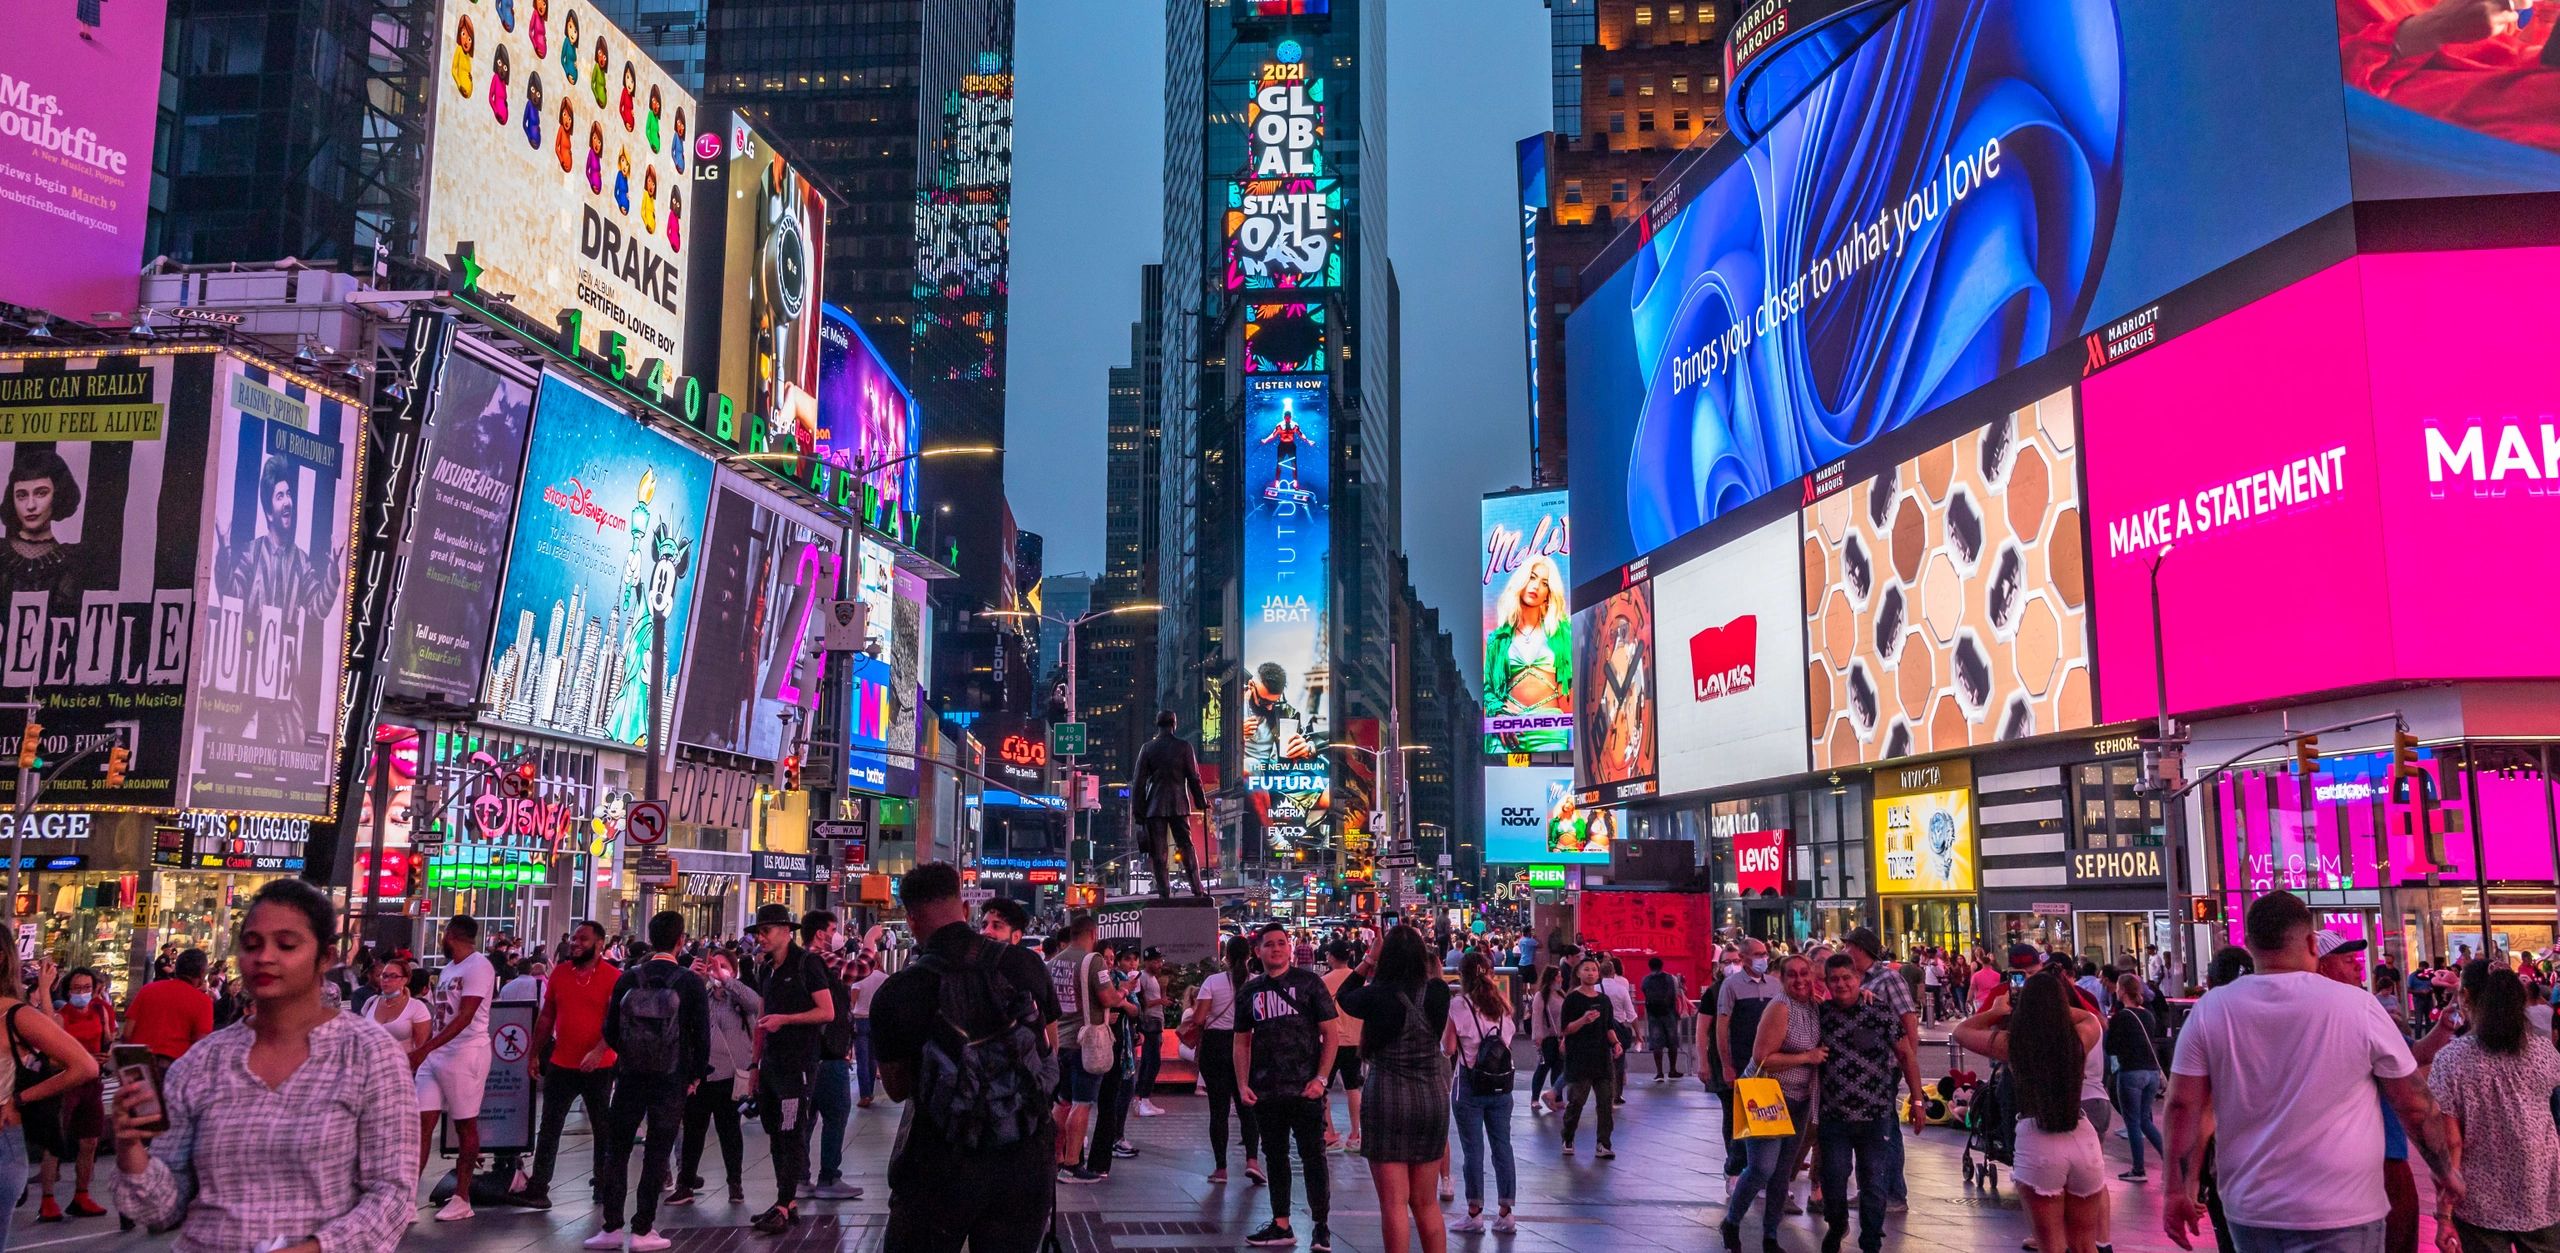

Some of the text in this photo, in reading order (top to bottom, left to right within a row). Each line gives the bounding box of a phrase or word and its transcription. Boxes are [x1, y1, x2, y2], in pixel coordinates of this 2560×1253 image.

[1736, 0, 1791, 44] MARRIO
[1737, 15, 1785, 67] MARQUIS
[1263, 63, 1304, 80] 2021
[0, 73, 63, 116] Mrs.
[42, 151, 58, 164] New
[744, 138, 755, 159] LG
[695, 165, 718, 181] LG
[35, 173, 67, 195] begin
[71, 186, 108, 209] March
[109, 200, 117, 211] 9
[1652, 183, 1681, 219] MARRIOTT
[0, 186, 118, 235] oubtfireBroadway.com
[1652, 203, 1678, 233] MARQUIS
[582, 202, 679, 316] DRAKE
[1673, 137, 2000, 395] Brings you closer to what you love
[578, 267, 615, 298] NEW ALBUM
[177, 307, 241, 324] LAMAR
[578, 283, 675, 355] CERTIFIED LOVER BOY
[2108, 306, 2159, 341] MARRIOTT
[830, 329, 849, 349] Movie
[2110, 327, 2155, 358] MARQUIS
[50, 376, 80, 399] CAN
[86, 373, 147, 396] REALLY
[1255, 380, 1322, 390] LISTEN NOW
[238, 382, 304, 428] RAISING SPIRITS
[22, 410, 157, 434] YOU FEEL ALIVE!
[275, 428, 335, 468] ON BROADWAY!
[1816, 460, 1846, 482] MARRIOTT
[1816, 475, 1843, 496] MARQUIS
[443, 495, 454, 507] not
[459, 500, 472, 512] real
[2109, 446, 2346, 558] MAKE A STATEMENT
[433, 528, 446, 541] But
[447, 533, 473, 551] wouldn't
[560, 528, 577, 547] HAVE
[579, 533, 590, 550] THE
[592, 542, 612, 559] MAGIC
[430, 549, 448, 561] great
[454, 557, 467, 569] you
[467, 560, 485, 573] could
[582, 556, 599, 570] YOUR
[600, 561, 617, 576] DOOR
[1262, 595, 1307, 609] JALA
[1264, 608, 1311, 623] BRAT
[0, 602, 185, 685] EETLE
[416, 624, 429, 639] Tell
[437, 634, 454, 645] your
[454, 635, 470, 649] plan
[993, 634, 1004, 682] 1500
[108, 694, 132, 708] The
[199, 697, 213, 711] The
[1493, 717, 1573, 730] SOFIA REYES
[216, 743, 277, 766] JAW-DROPPING
[2094, 736, 2140, 756] SEPHORA
[866, 767, 885, 785] brother
[1248, 763, 1325, 771] THE NEW ALBUM
[1901, 766, 1942, 788] INVICTA
[53, 779, 88, 791] THEATRE,
[1248, 776, 1325, 790] FUTURA
[668, 760, 757, 830] FOREVER
[1268, 808, 1306, 817] IMPERIA
[1501, 807, 1534, 817] OUT
[1501, 817, 1541, 827] NOW
[178, 812, 310, 843] GIFTS LUGGAGE
[819, 826, 860, 834] ONE WAY
[202, 855, 223, 867] Nikon
[226, 856, 252, 868] Canon
[256, 857, 283, 868] SONY
[764, 855, 774, 868] U.S.
[775, 856, 791, 870] POLO
[2075, 850, 2160, 879] SEPHORA
[1030, 871, 1057, 881] ESPN
[136, 894, 147, 924] ATM
[21, 934, 30, 953] 7
